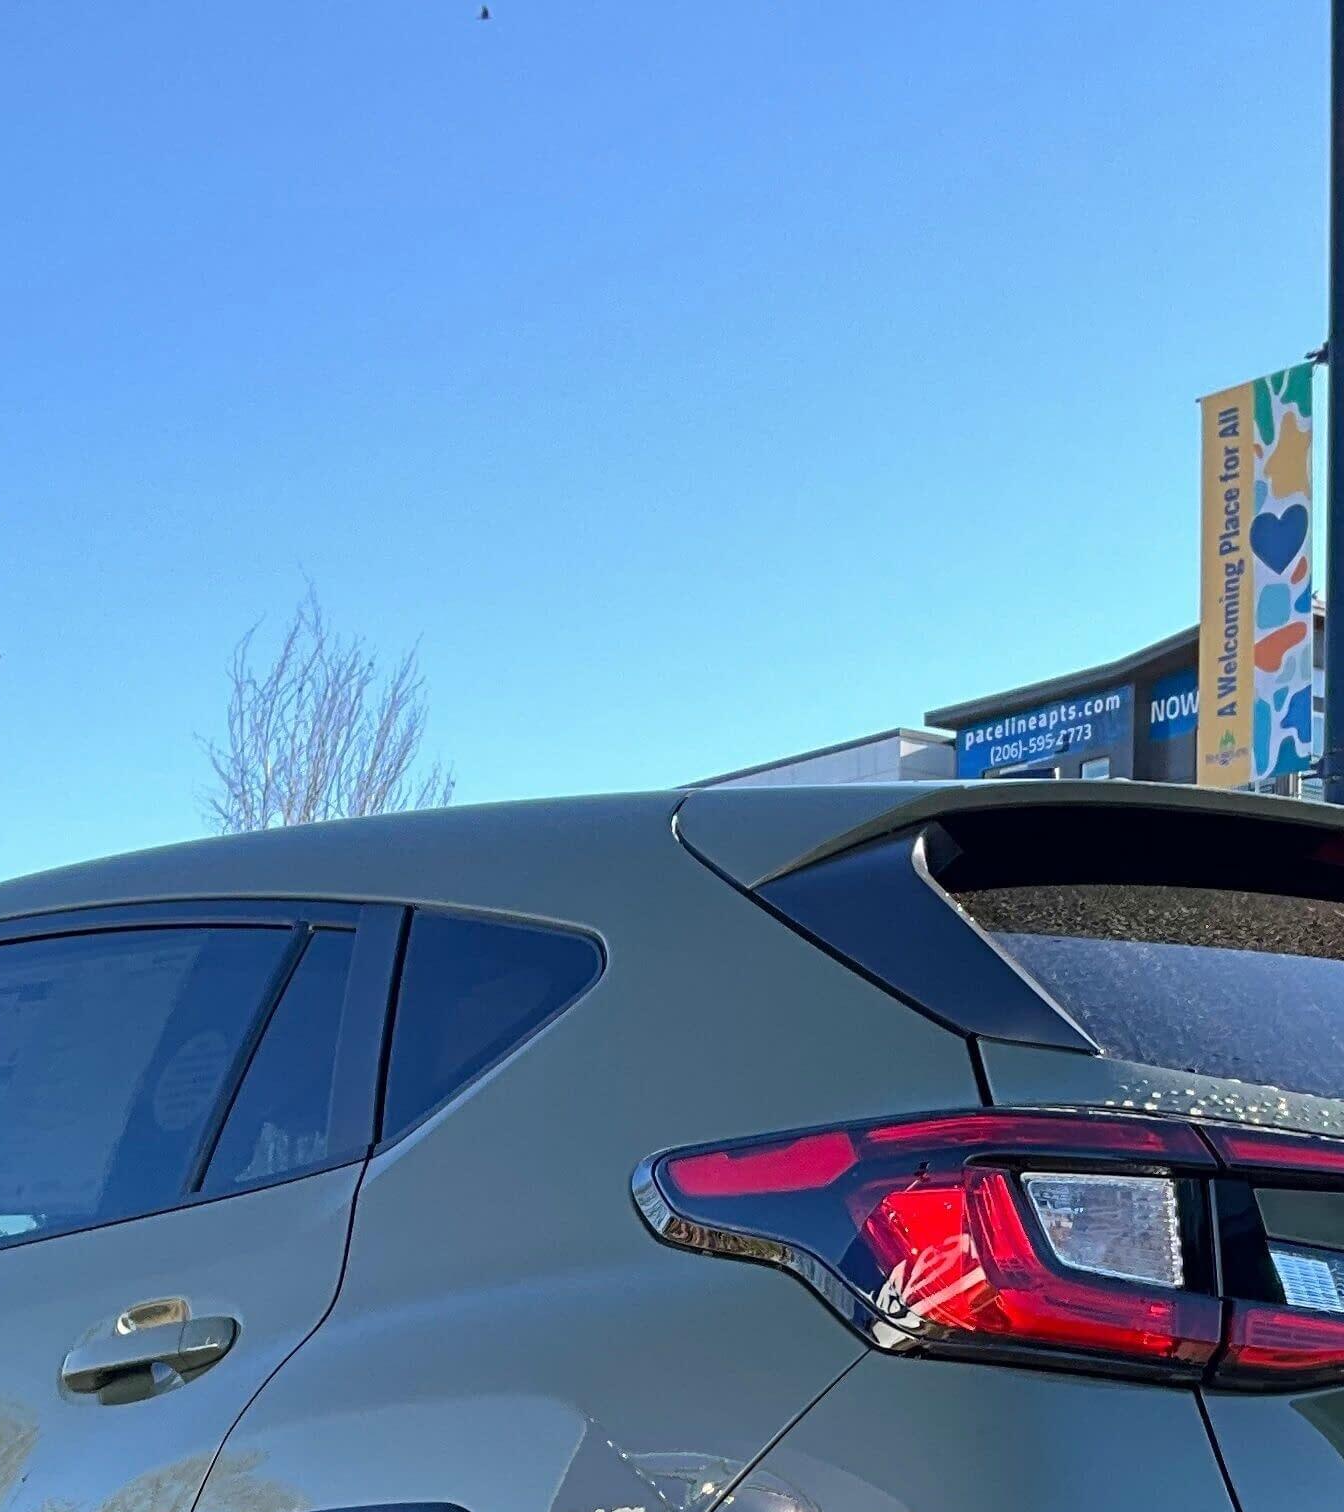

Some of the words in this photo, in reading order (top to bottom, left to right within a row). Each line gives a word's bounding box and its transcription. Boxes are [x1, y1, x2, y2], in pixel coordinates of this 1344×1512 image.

[1218, 407, 1240, 438] All
[1219, 446, 1240, 483] for
[1219, 488, 1241, 556] Place
[1217, 558, 1244, 700] Welcoming
[964, 694, 1121, 751] pacelineapts.com
[1151, 691, 1199, 724] NOW
[1217, 701, 1239, 717] A
